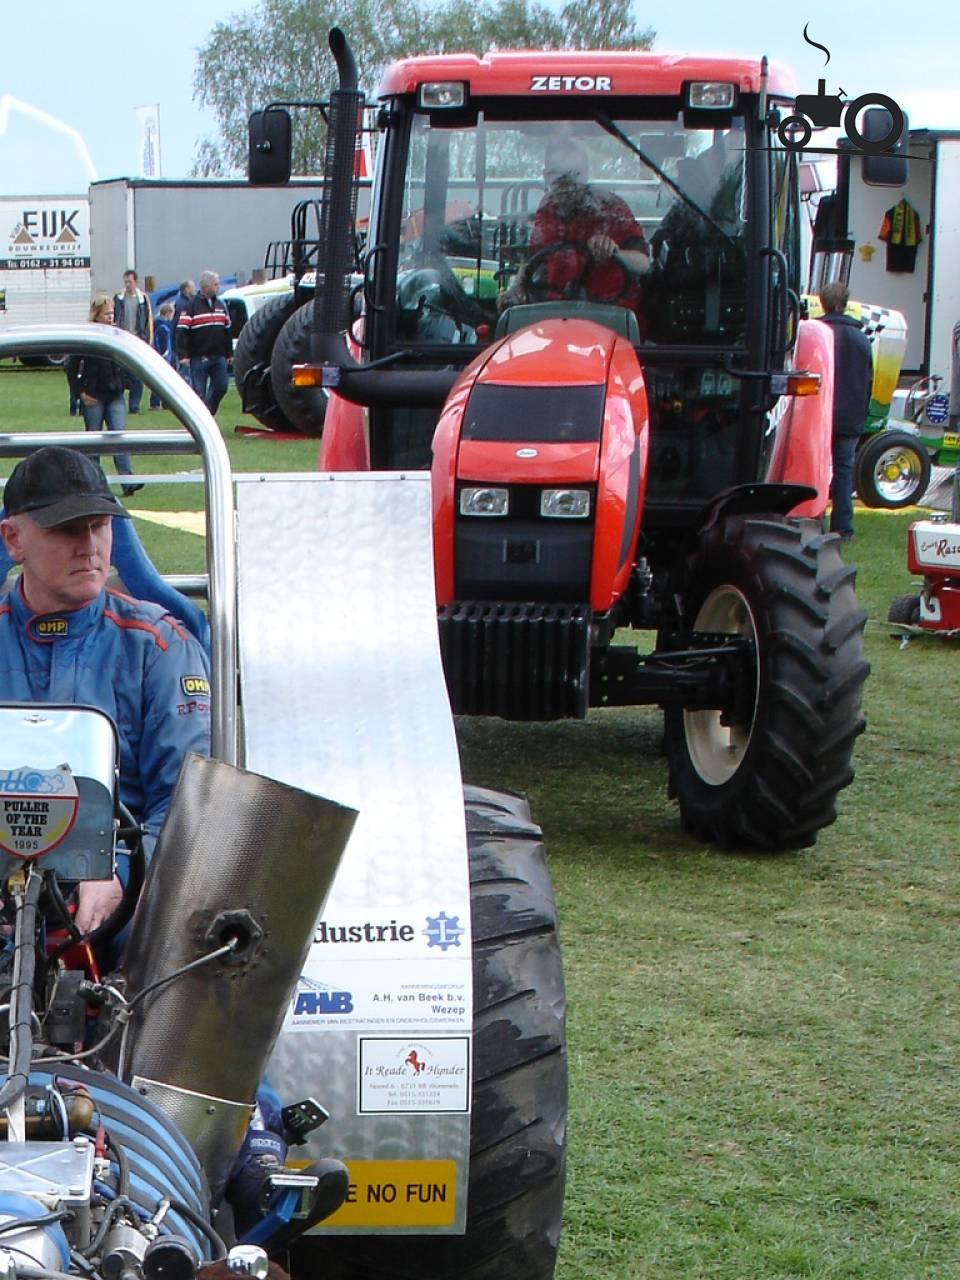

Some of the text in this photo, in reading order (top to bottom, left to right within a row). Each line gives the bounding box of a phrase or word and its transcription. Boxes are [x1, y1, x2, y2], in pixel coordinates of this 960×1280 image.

[530, 76, 611, 91] ZETOR
[23, 211, 80, 237] EIJK
[19, 259, 41, 268] 0162
[49, 259, 60, 267] 31
[62, 259, 73, 267] 94
[74, 258, 85, 267] 01
[39, 621, 66, 632] OMP
[4, 801, 50, 813] PULLER
[6, 814, 48, 825] OF THE
[10, 826, 43, 837] YEAR
[14, 840, 39, 849] 1995
[372, 993, 465, 1002] A.H. van Beek b.v.
[430, 1005, 466, 1015] Wezep
[367, 1184, 397, 1204] NO
[406, 1183, 446, 1203] FUN
